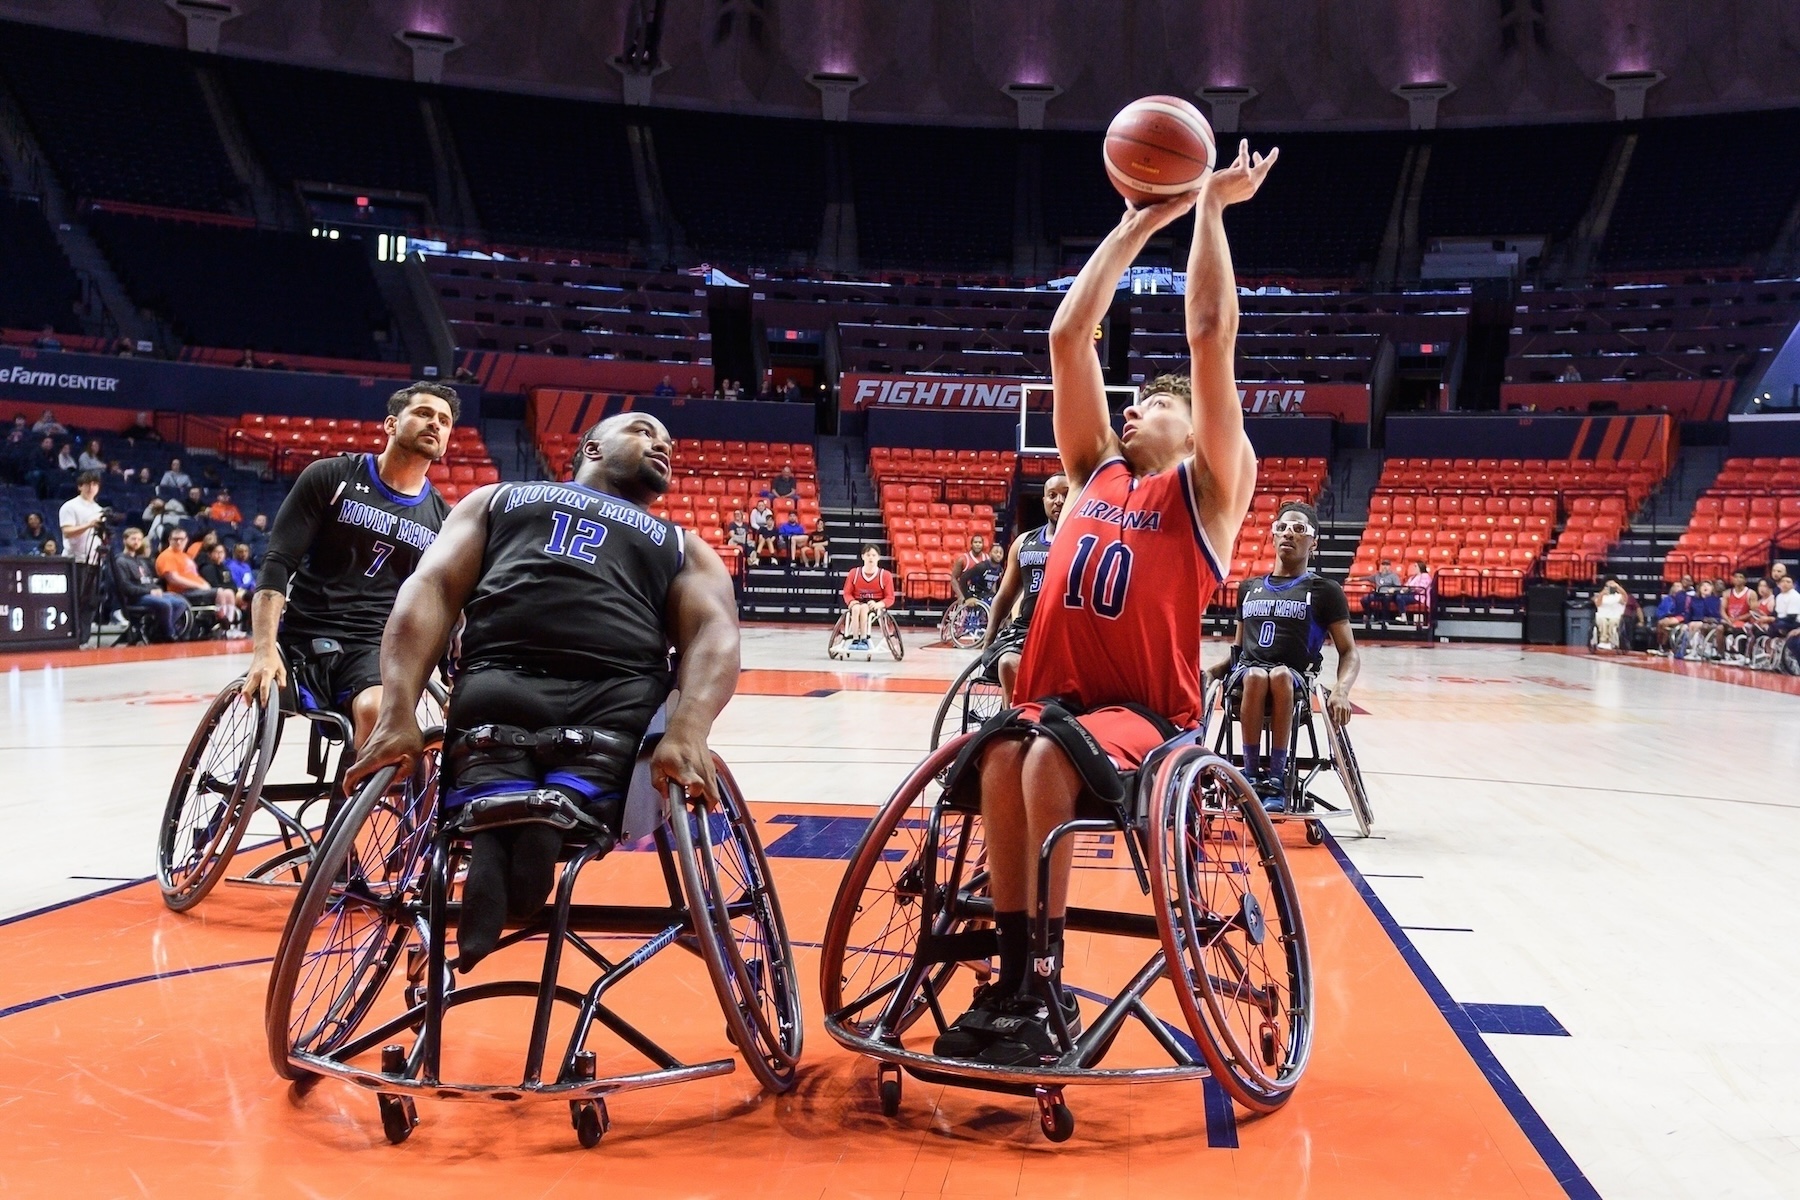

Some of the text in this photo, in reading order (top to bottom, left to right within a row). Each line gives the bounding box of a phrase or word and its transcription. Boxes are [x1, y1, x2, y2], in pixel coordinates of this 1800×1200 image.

[58, 374, 119, 391] CENTER
[854, 380, 1022, 407] FIGHTING
[337, 499, 398, 536] MOVIN'
[504, 484, 667, 546] MOVIN' MAVS
[544, 510, 608, 564] 12
[364, 540, 395, 577] 7
[1063, 533, 1133, 621] 10
[1273, 599, 1307, 620] MAVS
[1258, 620, 1276, 647] 0
[1033, 955, 1056, 977] RGK
